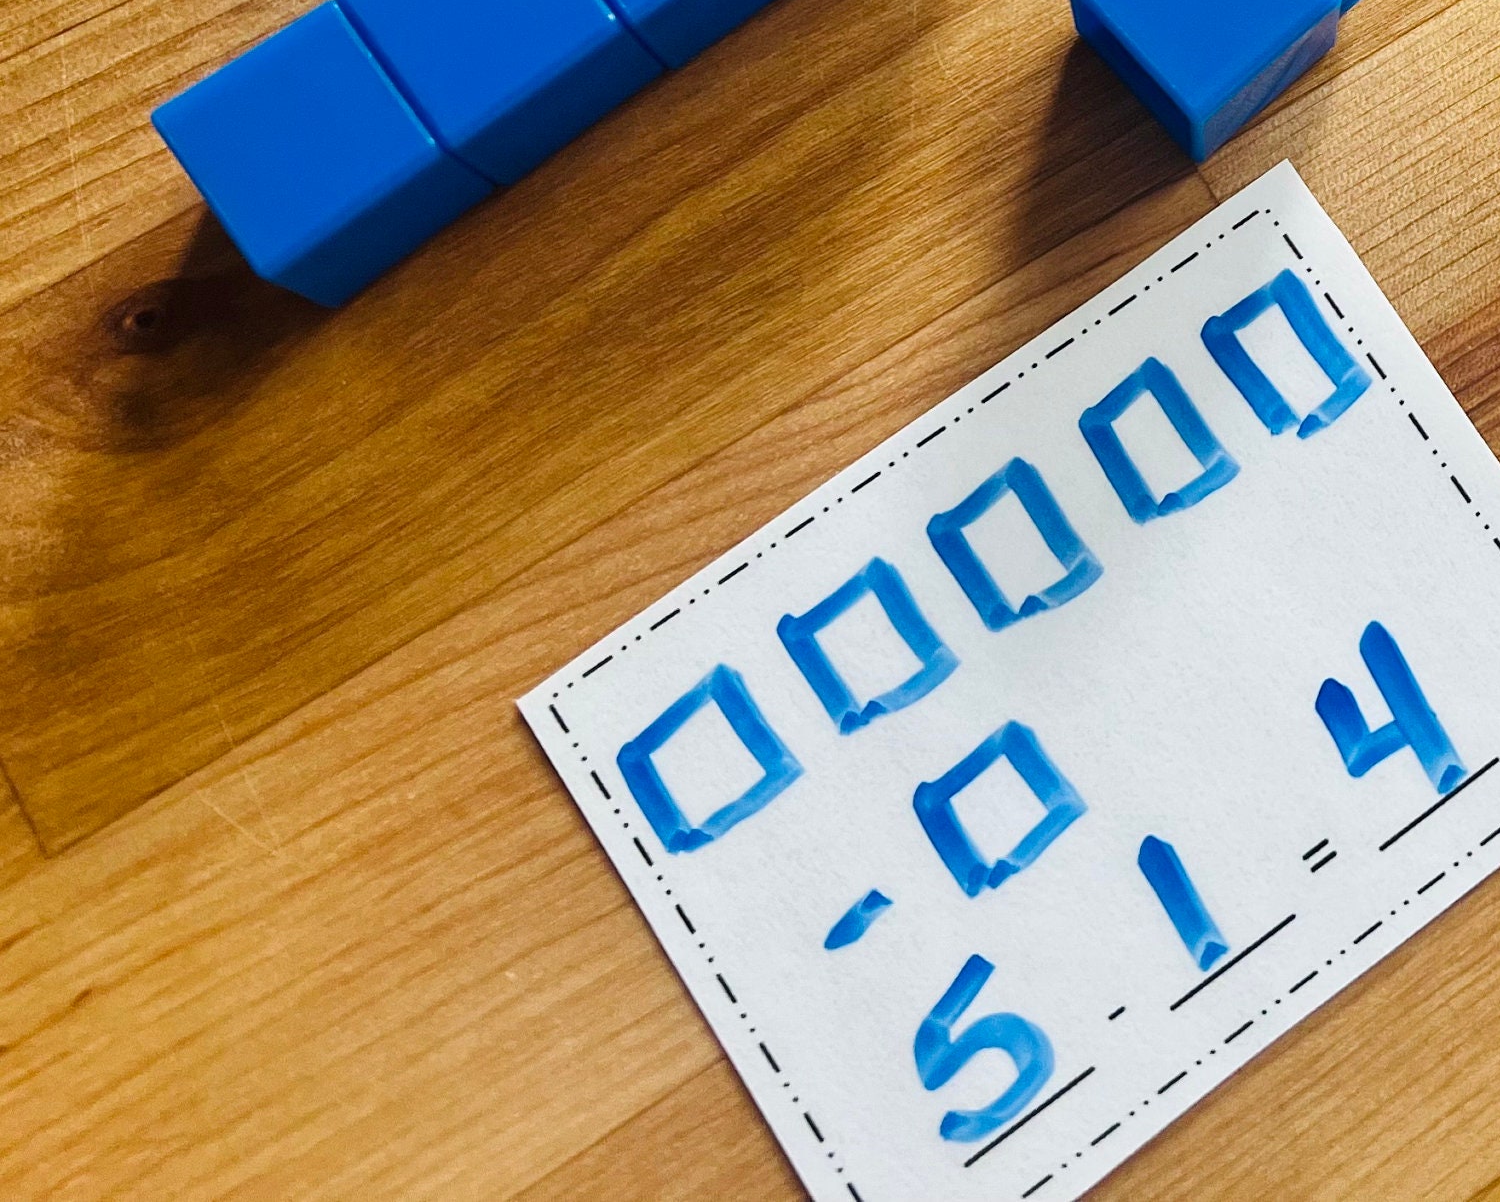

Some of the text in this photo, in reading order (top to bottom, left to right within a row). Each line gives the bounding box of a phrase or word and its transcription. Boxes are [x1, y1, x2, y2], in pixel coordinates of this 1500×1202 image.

[913, 953, 1055, 1144] 5
[1137, 834, 1230, 972] 1
[1314, 620, 1469, 797] 4
